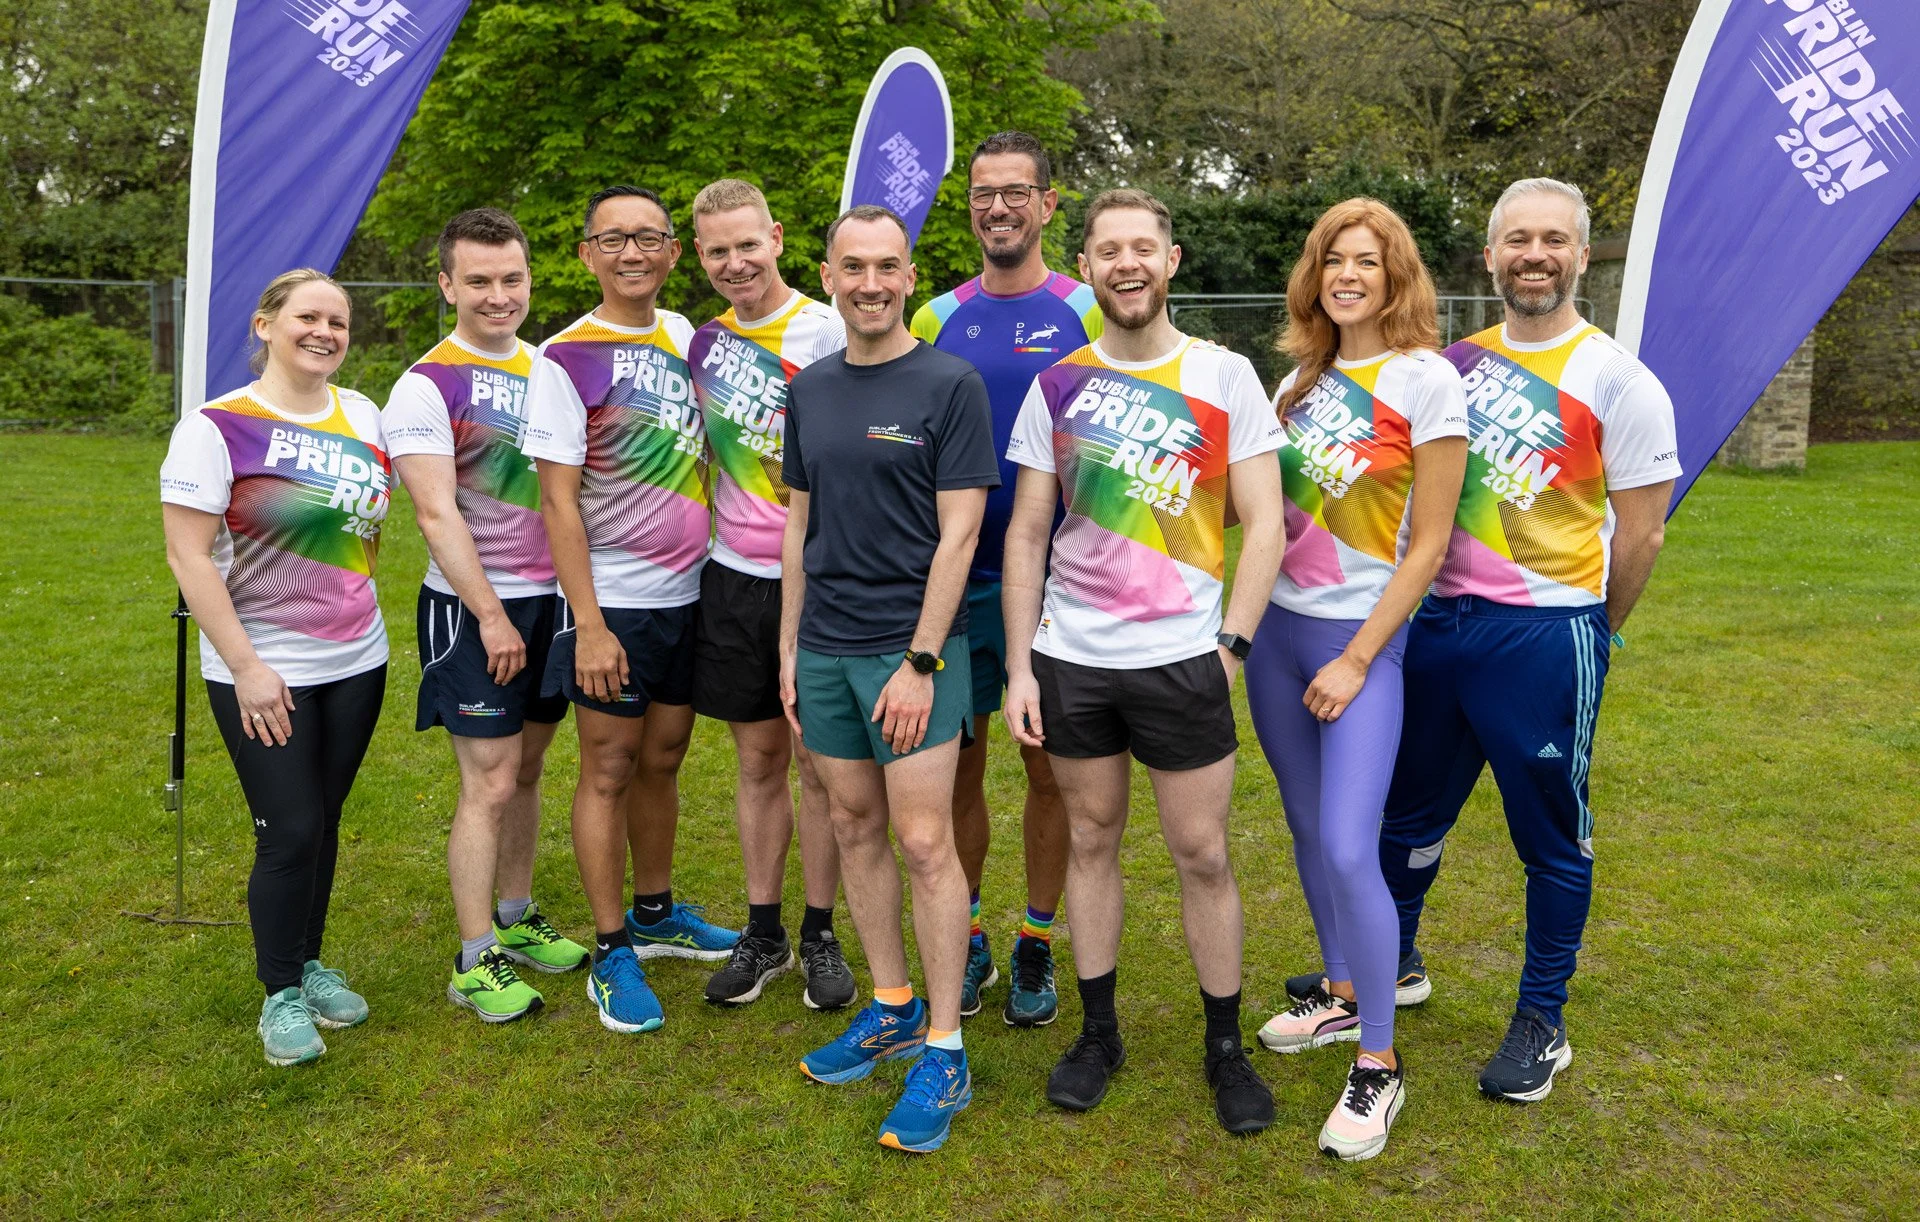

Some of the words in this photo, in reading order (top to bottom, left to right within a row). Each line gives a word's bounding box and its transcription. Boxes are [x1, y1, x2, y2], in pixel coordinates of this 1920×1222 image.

[308, 4, 405, 76] RUN
[1825, 0, 1877, 48] BLIN
[316, 47, 375, 87] 2023
[893, 131, 921, 158] DUBLIN
[1775, 72, 1890, 192] RUN
[878, 137, 931, 188] PRIDE
[1774, 127, 1846, 206] 2023
[884, 170, 926, 209] RUN
[716, 331, 759, 364] DUBLIN
[472, 369, 526, 393] DUBLIN
[702, 342, 788, 408] PRIDE
[1084, 377, 1153, 406] DUBLIN
[1316, 372, 1349, 401] DUBLIN
[1475, 356, 1530, 392] DUBLIN
[1064, 390, 1202, 456] PRIDE
[1294, 384, 1376, 444] PRIDE
[1461, 368, 1560, 446] PRIDE
[270, 427, 343, 453] DUBLIN
[1295, 424, 1373, 486] RUN
[1468, 422, 1562, 495] RUN
[263, 438, 389, 491] PRIDE
[1109, 438, 1202, 500] RUN
[1299, 459, 1349, 499] 2023
[1124, 480, 1188, 517] 2023
[1479, 467, 1537, 511] 2023
[340, 515, 380, 540] 202
